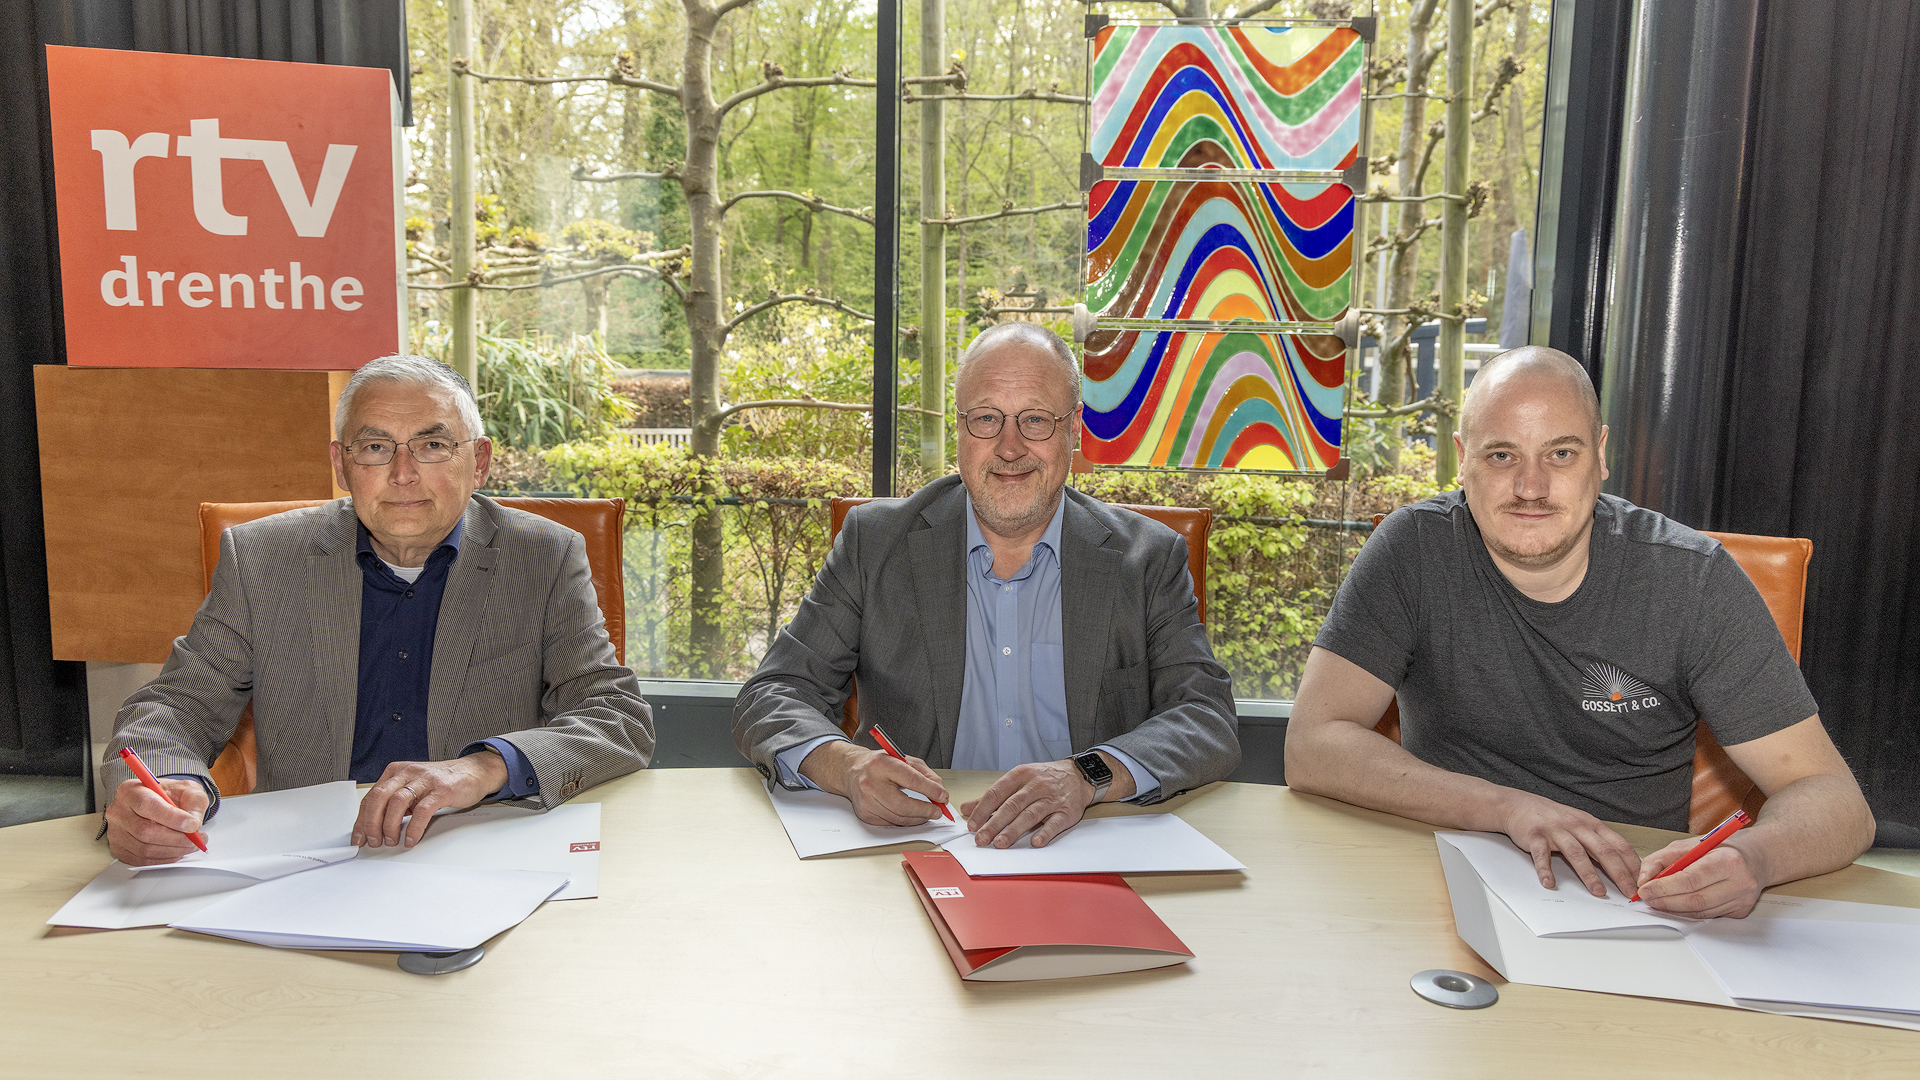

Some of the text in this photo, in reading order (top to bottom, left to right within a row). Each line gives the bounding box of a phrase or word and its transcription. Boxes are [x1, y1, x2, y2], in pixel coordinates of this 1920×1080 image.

[91, 118, 358, 237] rtv
[101, 255, 364, 311] drenthe
[1582, 696, 1661, 713] GOSSETT & CO.
